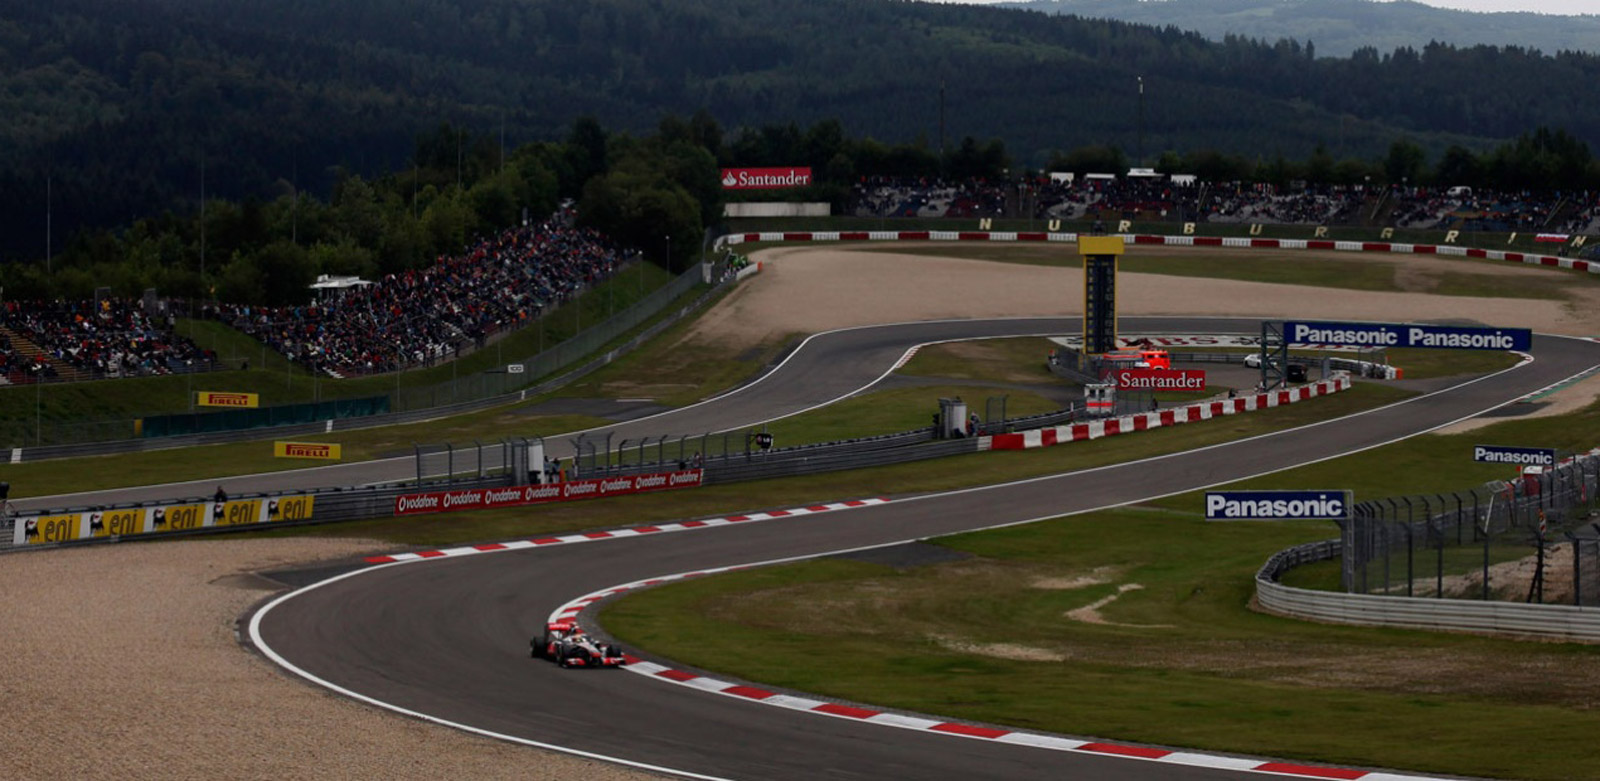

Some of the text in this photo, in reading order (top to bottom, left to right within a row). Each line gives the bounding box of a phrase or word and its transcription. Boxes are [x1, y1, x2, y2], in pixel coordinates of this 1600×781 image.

[738, 169, 809, 187] Santander
[1294, 324, 1514, 349] Panasonic Panasonic
[1120, 370, 1205, 389] Santander
[209, 394, 248, 406] PIRELLI
[286, 444, 329, 457] PIRELLI
[1474, 446, 1553, 466] Panasonic
[1206, 494, 1343, 518] Panasonic
[45, 496, 306, 542] eni eni eni eni eni
